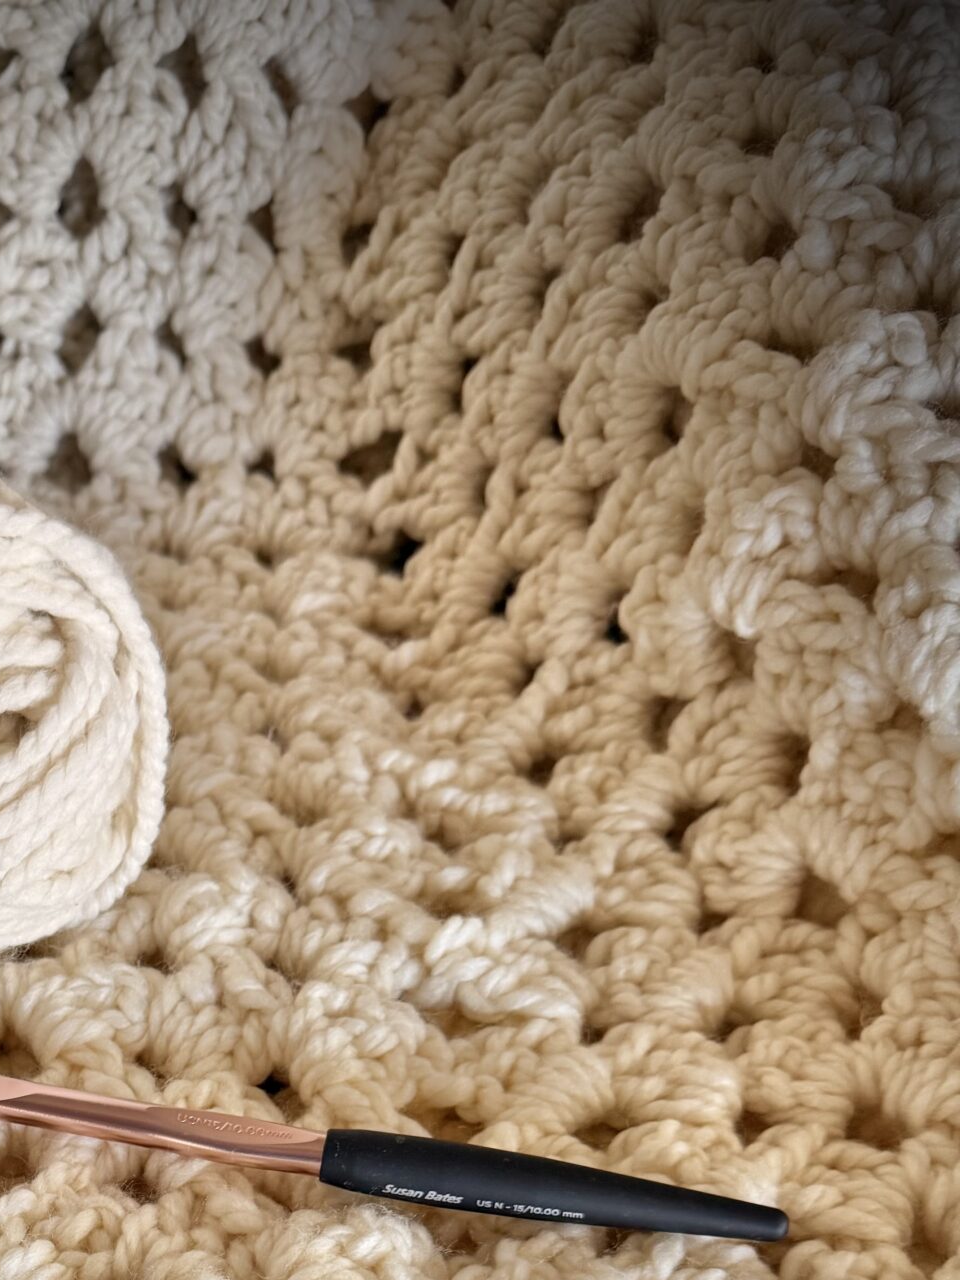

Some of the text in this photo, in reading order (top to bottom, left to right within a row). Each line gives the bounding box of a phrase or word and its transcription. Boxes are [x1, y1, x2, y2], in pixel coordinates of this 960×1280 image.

[382, 1184, 423, 1199] Susan
[424, 1190, 464, 1204] Bates
[476, 1199, 492, 1209] US
[494, 1201, 504, 1210] N
[513, 1203, 561, 1216] 15/10.00
[561, 1210, 584, 1220] mm
